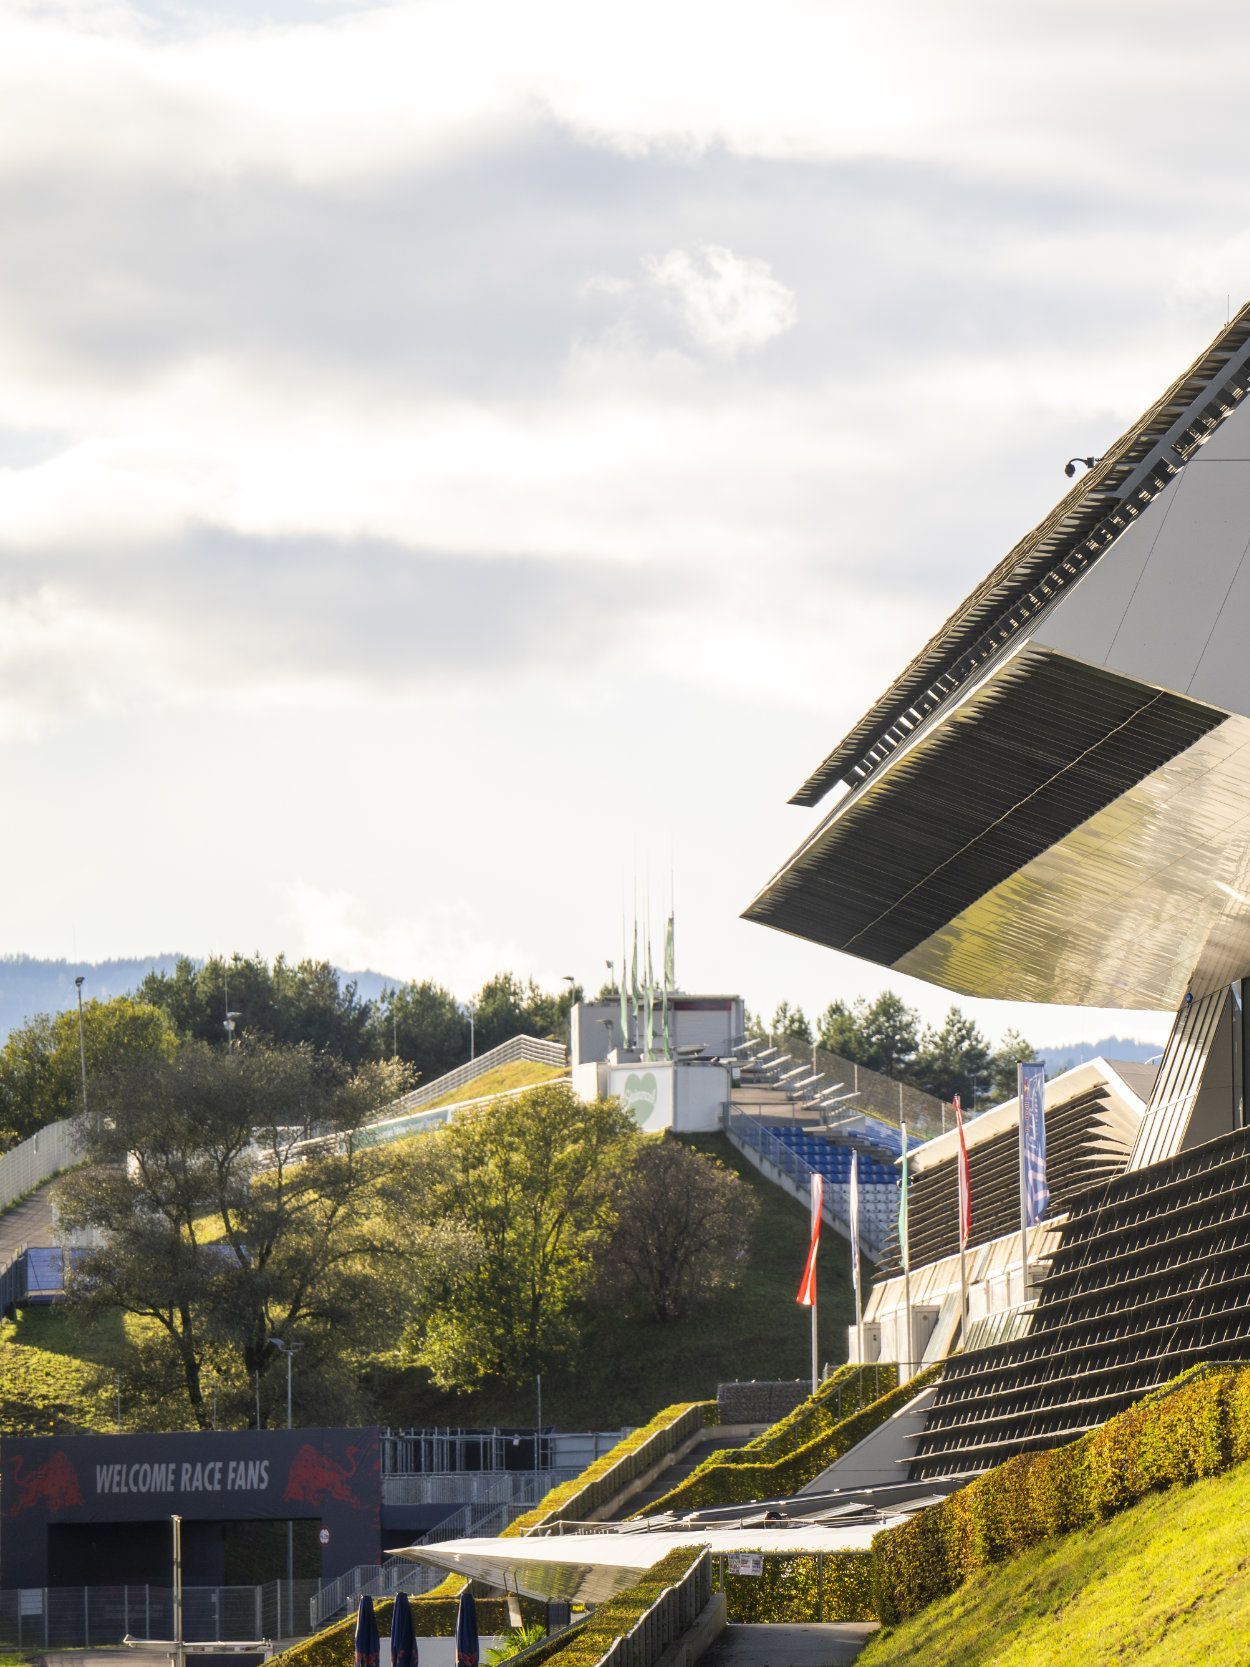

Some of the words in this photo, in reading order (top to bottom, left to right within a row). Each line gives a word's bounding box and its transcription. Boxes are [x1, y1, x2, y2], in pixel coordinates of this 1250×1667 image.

[96, 1463, 177, 1494] WELCOME
[180, 1461, 224, 1492] RACE
[227, 1459, 270, 1490] FANS
